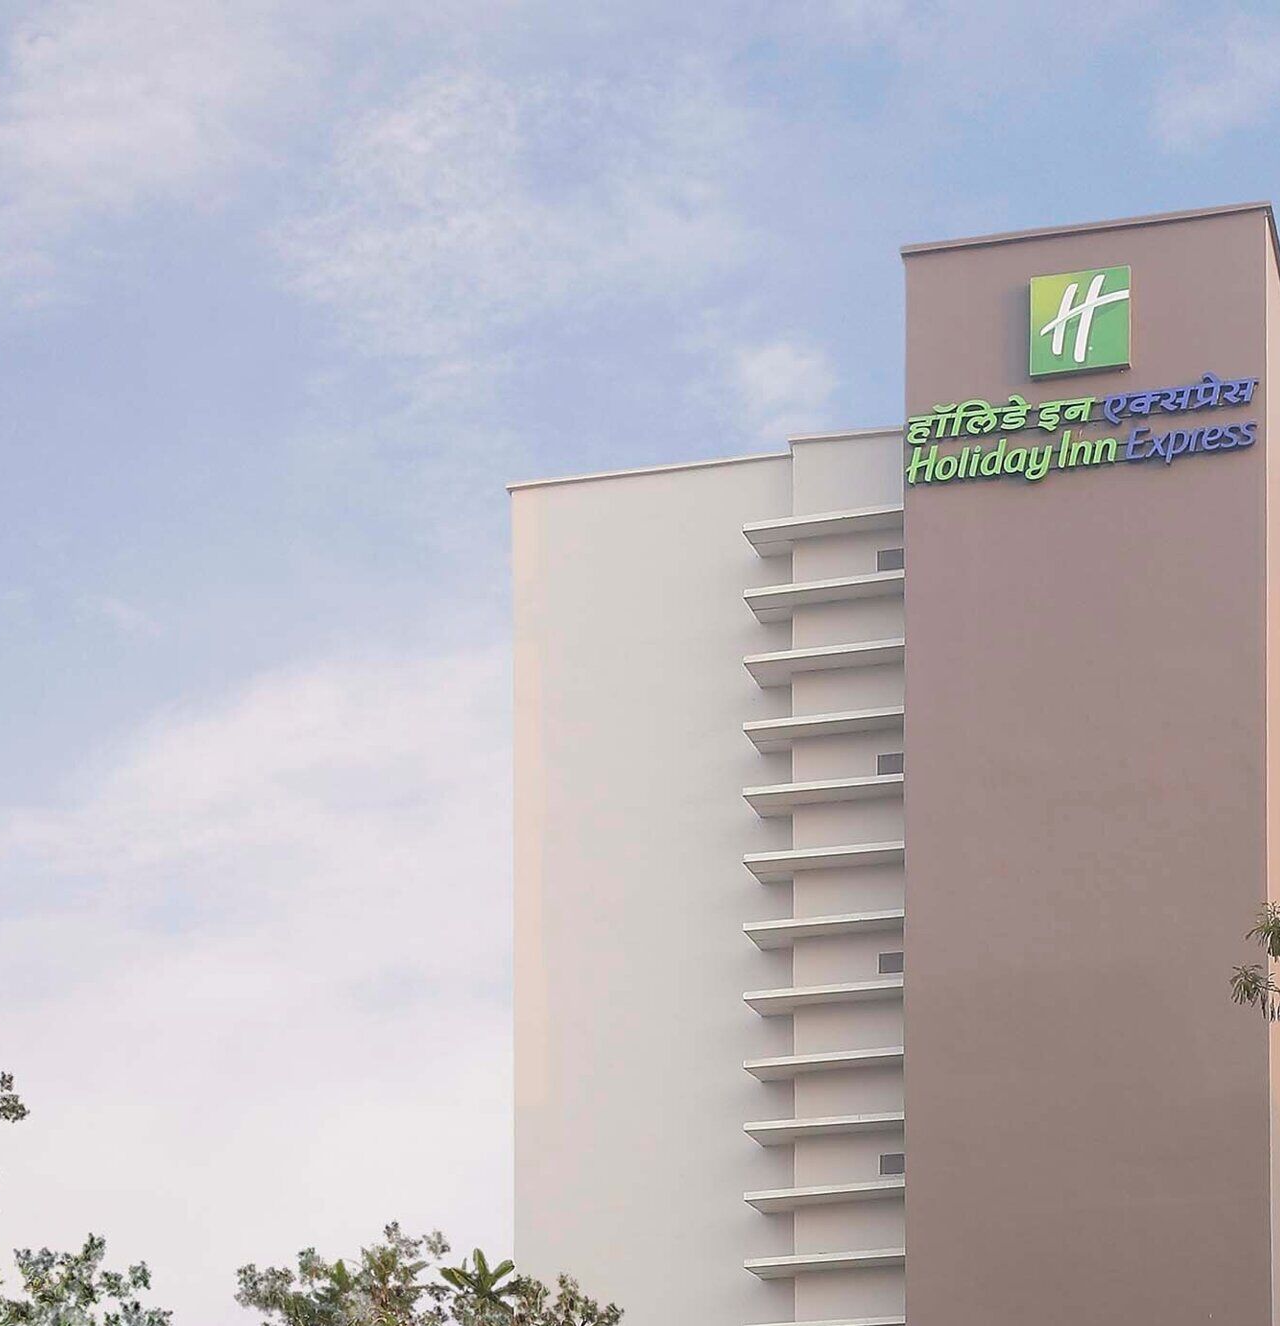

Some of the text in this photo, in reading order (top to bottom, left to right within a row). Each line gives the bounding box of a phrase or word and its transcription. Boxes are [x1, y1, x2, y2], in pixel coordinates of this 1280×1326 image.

[907, 371, 1259, 445] हॉलिडे इन एक्सप्रेस
[906, 420, 1259, 484] Holiday Inn Express
